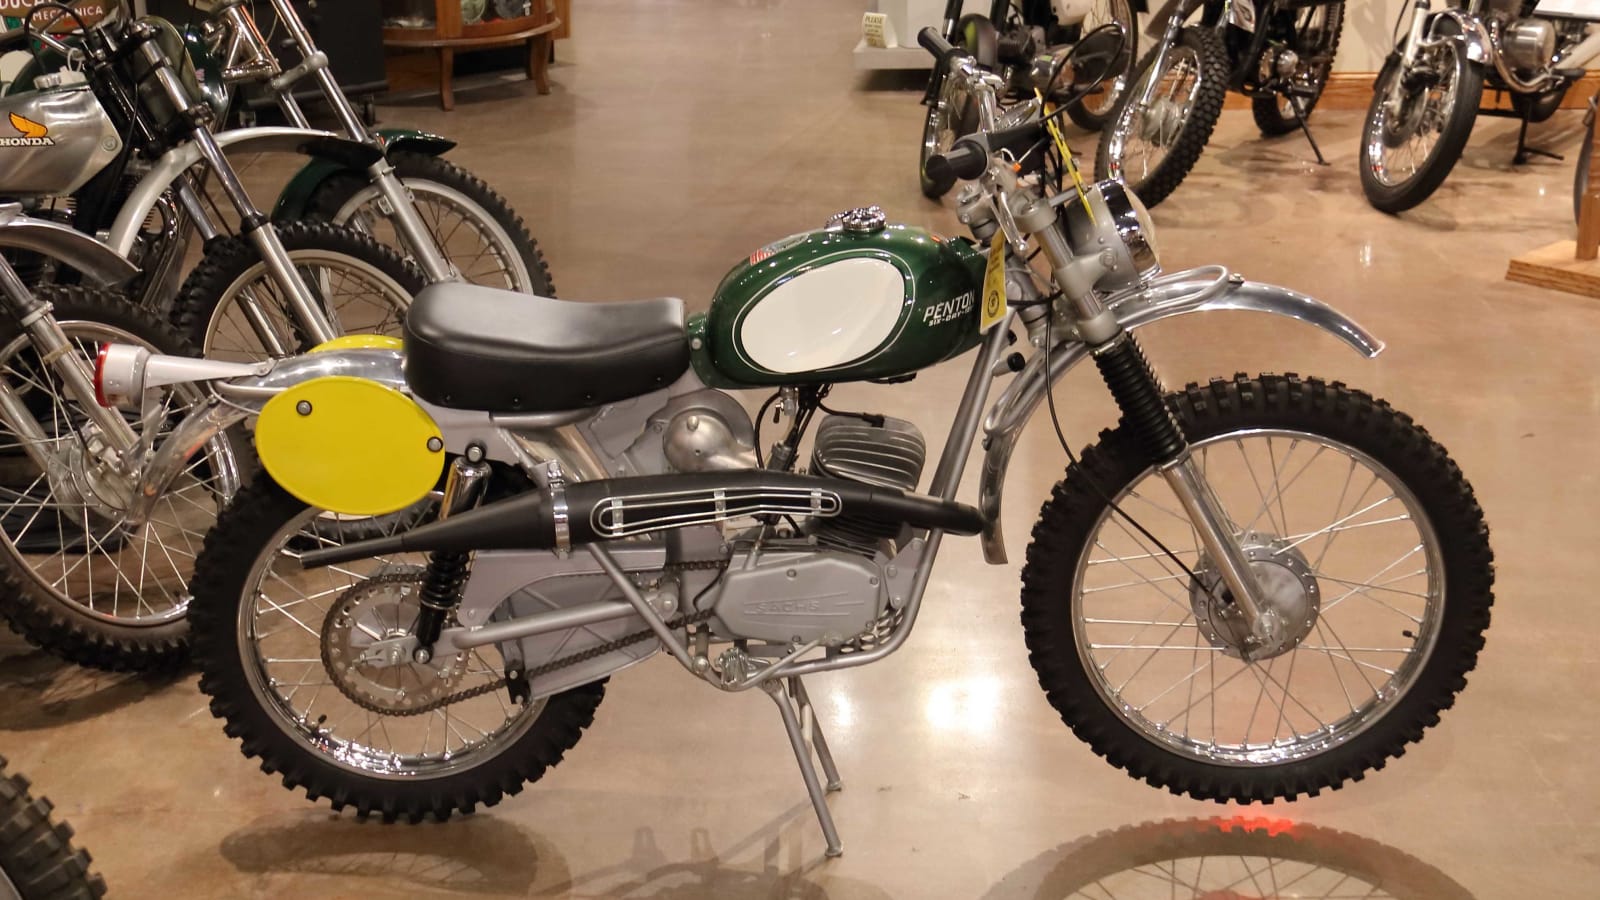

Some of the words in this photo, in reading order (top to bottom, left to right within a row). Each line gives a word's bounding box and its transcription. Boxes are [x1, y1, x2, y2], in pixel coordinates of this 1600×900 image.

[0, 138, 54, 146] HONDA
[923, 289, 975, 322] PENTON
[756, 600, 820, 613] SACHS
